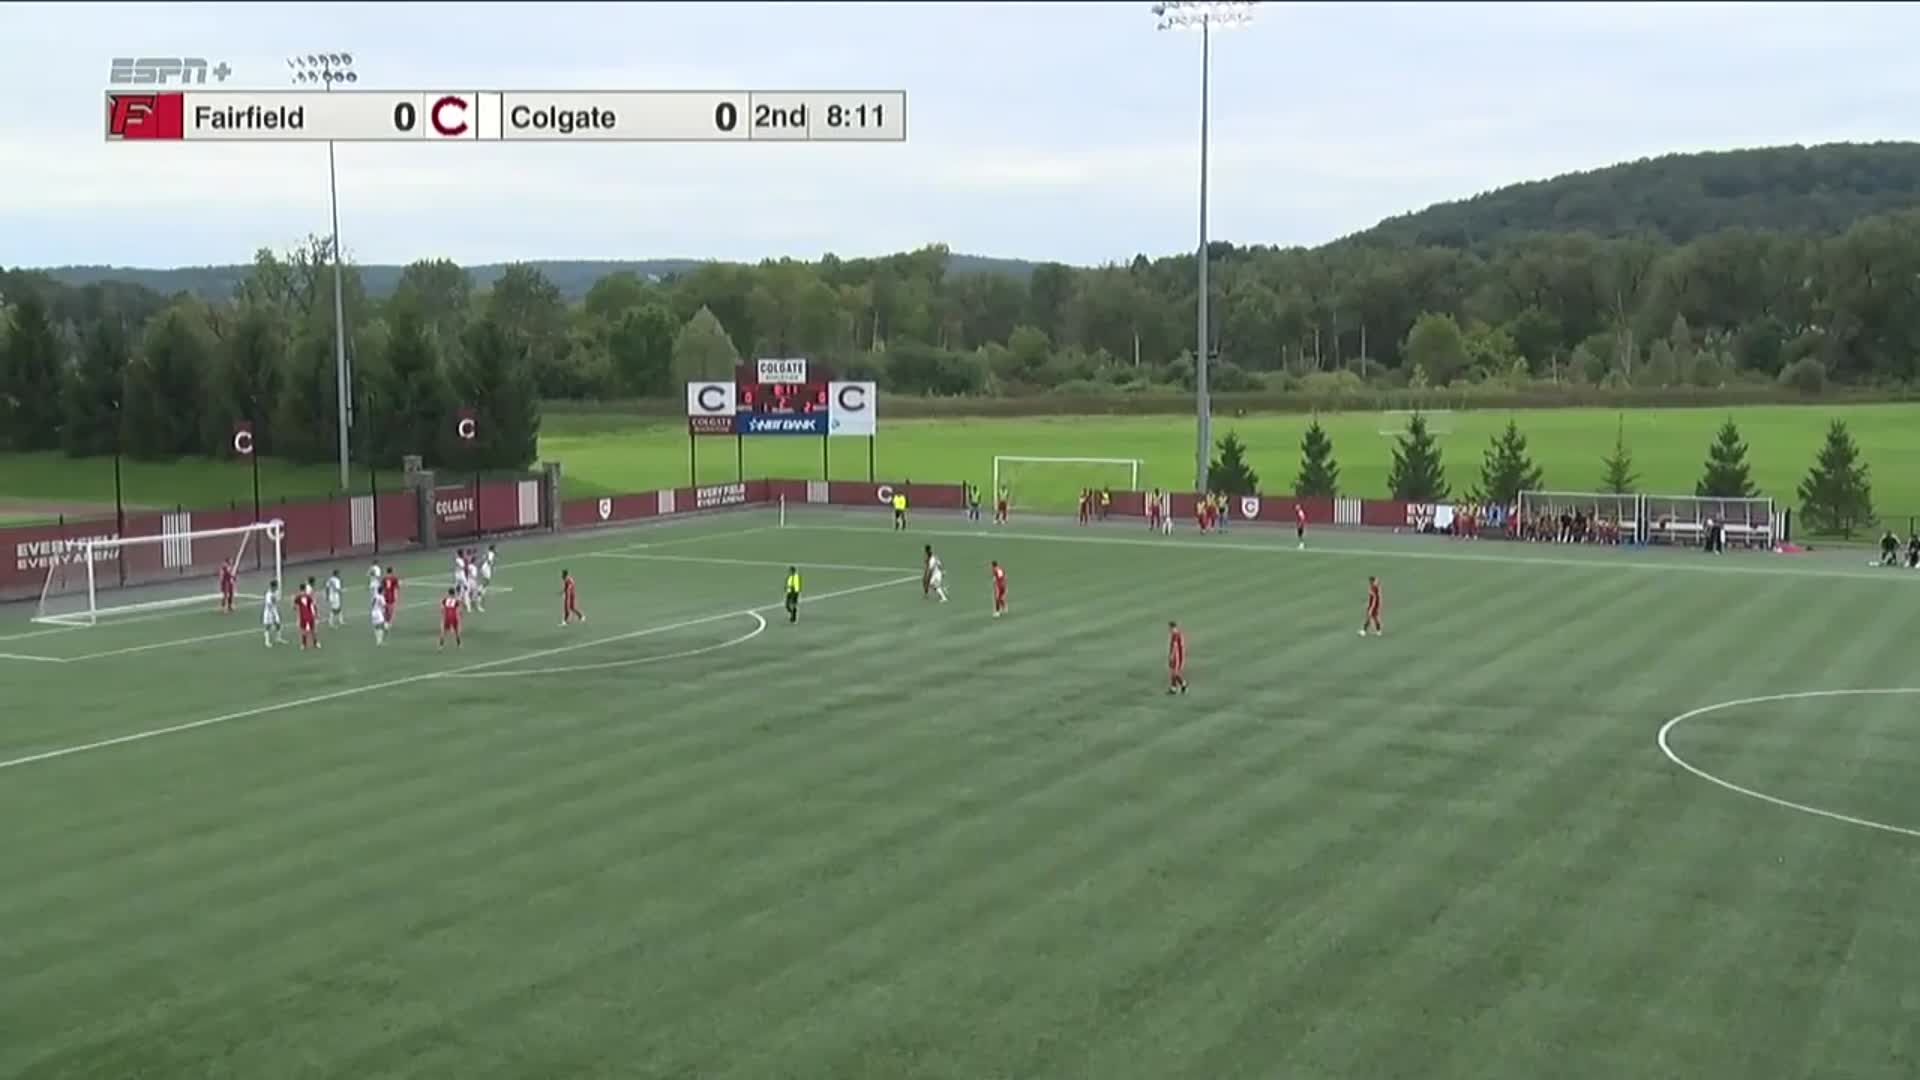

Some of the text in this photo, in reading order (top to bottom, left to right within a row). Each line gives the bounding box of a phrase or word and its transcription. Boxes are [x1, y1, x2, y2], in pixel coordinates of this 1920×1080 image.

[760, 362, 803, 373] COLGATE
[697, 385, 726, 412] C
[838, 385, 865, 412] C
[459, 418, 476, 439] C
[235, 431, 253, 454] C
[436, 498, 474, 515] COLGATE
[17, 539, 74, 557] EVERY
